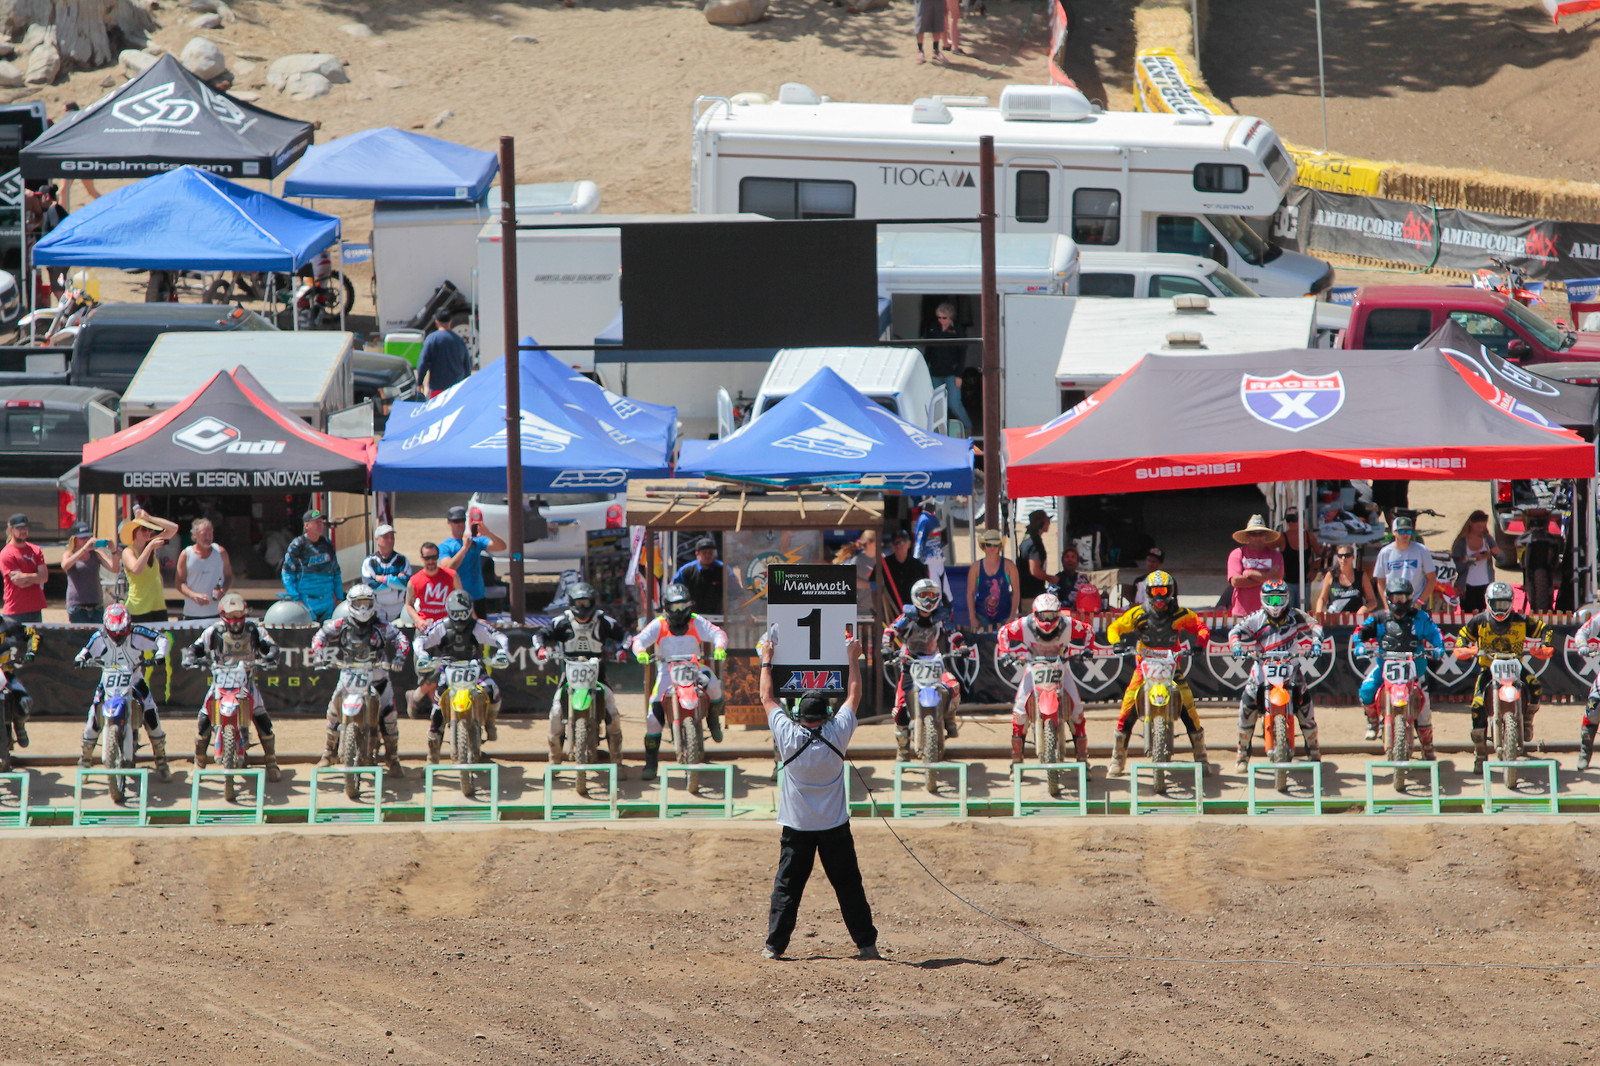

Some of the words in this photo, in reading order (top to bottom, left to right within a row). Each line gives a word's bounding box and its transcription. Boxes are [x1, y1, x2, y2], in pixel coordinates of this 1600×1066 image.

[61, 160, 233, 173] 6Dhelmetscom
[879, 166, 950, 187] TIOGA
[1313, 209, 1404, 237] AMERICORE
[1440, 228, 1527, 253] AMERICORE
[1250, 379, 1335, 389] RACER
[1270, 392, 1319, 420] X
[1136, 463, 1241, 479] SUBSCRIBE!
[1360, 457, 1466, 469] SUBSCRIBE!
[123, 472, 193, 488] OBSERVE.
[196, 472, 250, 487] DESIGN.
[253, 471, 324, 487] INNOVATE.
[784, 579, 851, 592] Mammoth
[797, 608, 821, 660] 1
[1082, 659, 1109, 682] X
[1222, 656, 1249, 678] X
[1266, 665, 1288, 678] 30
[1386, 662, 1411, 681] 51
[1493, 663, 1518, 679] 444
[106, 674, 131, 688] 813
[451, 669, 476, 683] 66
[780, 670, 844, 690] AMA
[1034, 668, 1062, 684] 312
